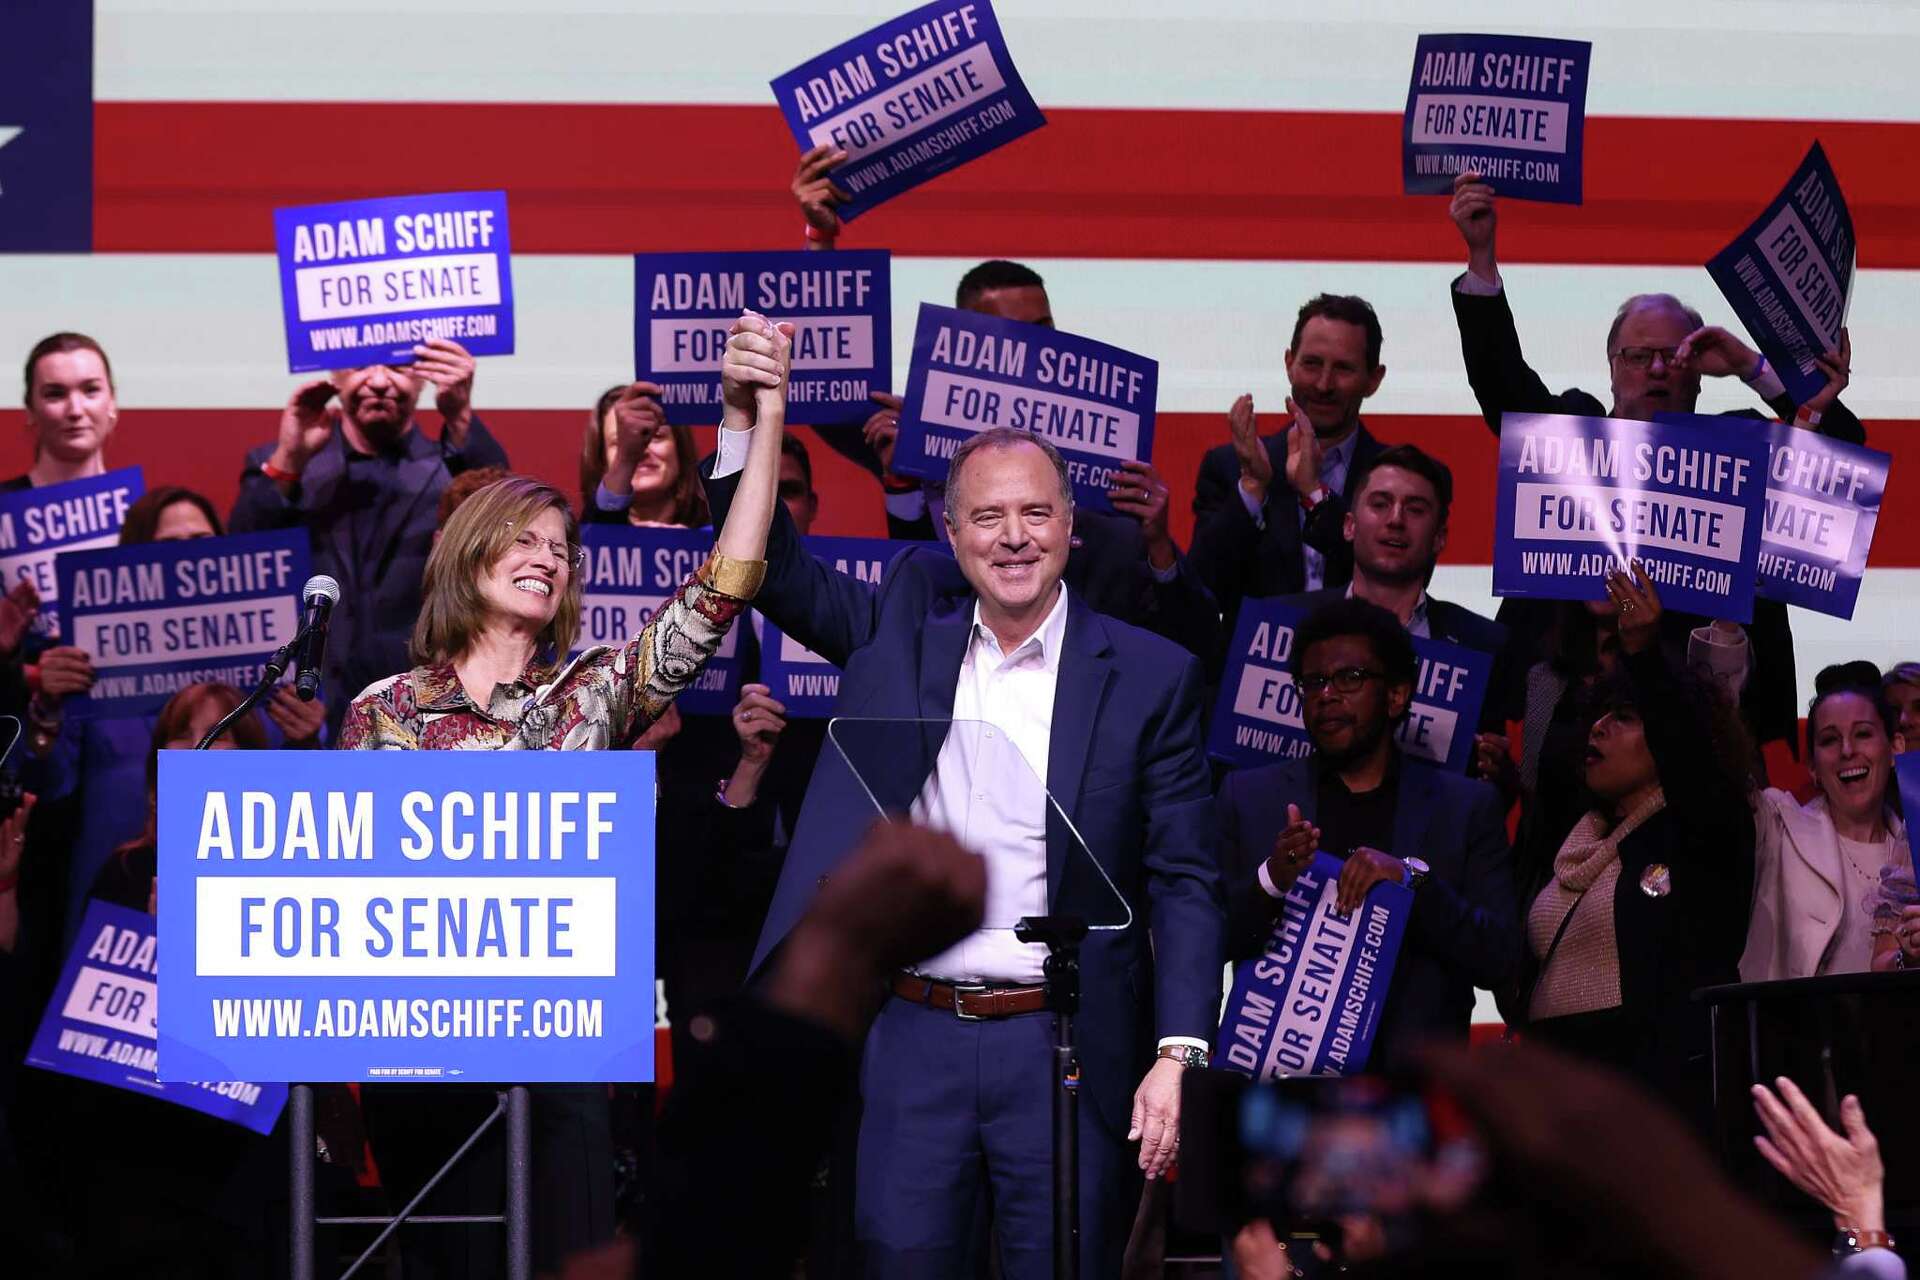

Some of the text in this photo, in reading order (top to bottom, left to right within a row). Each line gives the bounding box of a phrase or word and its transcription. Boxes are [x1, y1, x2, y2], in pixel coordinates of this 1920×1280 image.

[794, 4, 978, 124] ADAM SCHIFF
[1419, 52, 1575, 94] ADAM SCHIFF
[830, 60, 984, 151] FOR SENATE
[1424, 104, 1549, 142] FOR SENATE
[846, 100, 1017, 193] WWW.ADAMSCHIFF.COM
[1415, 155, 1560, 183] WWW.ADAMSCHIFF.COM
[1795, 169, 1838, 246] ADAM
[293, 210, 495, 263] ADAM SCHIFF
[320, 265, 482, 308] FOR SENATE
[651, 270, 872, 311] ADAM SCHIFF
[1770, 224, 1842, 344] FOR SENATE
[310, 315, 497, 352] WWW.ADAMSCHIFF.COM
[674, 329, 727, 362] FOR
[930, 326, 1144, 405] ADAM SCHIFF
[945, 384, 1000, 425] FOR
[1010, 397, 1120, 448] SENATE
[1517, 435, 1750, 497] ADAM SCHIFF
[1771, 445, 1870, 501] CHIFF
[24, 488, 130, 545] SCHIFF
[1538, 494, 1723, 548] FOR SENATE
[73, 562, 165, 608] ADAM
[175, 550, 293, 598] SCHIFF
[96, 622, 153, 658] FOR
[163, 608, 278, 652] SENATE
[1248, 621, 1294, 663] AD
[1258, 679, 1304, 719] FO
[196, 790, 617, 861] ADAM SCHIFF
[87, 924, 157, 975] ADA
[240, 897, 574, 958] FOR SENATE
[1226, 871, 1319, 1080] DAM SCHIFF
[1293, 903, 1352, 1022] SENATE
[87, 982, 147, 1023] FOR
[212, 998, 603, 1038] WWW.ADAMSCHIFF.COM
